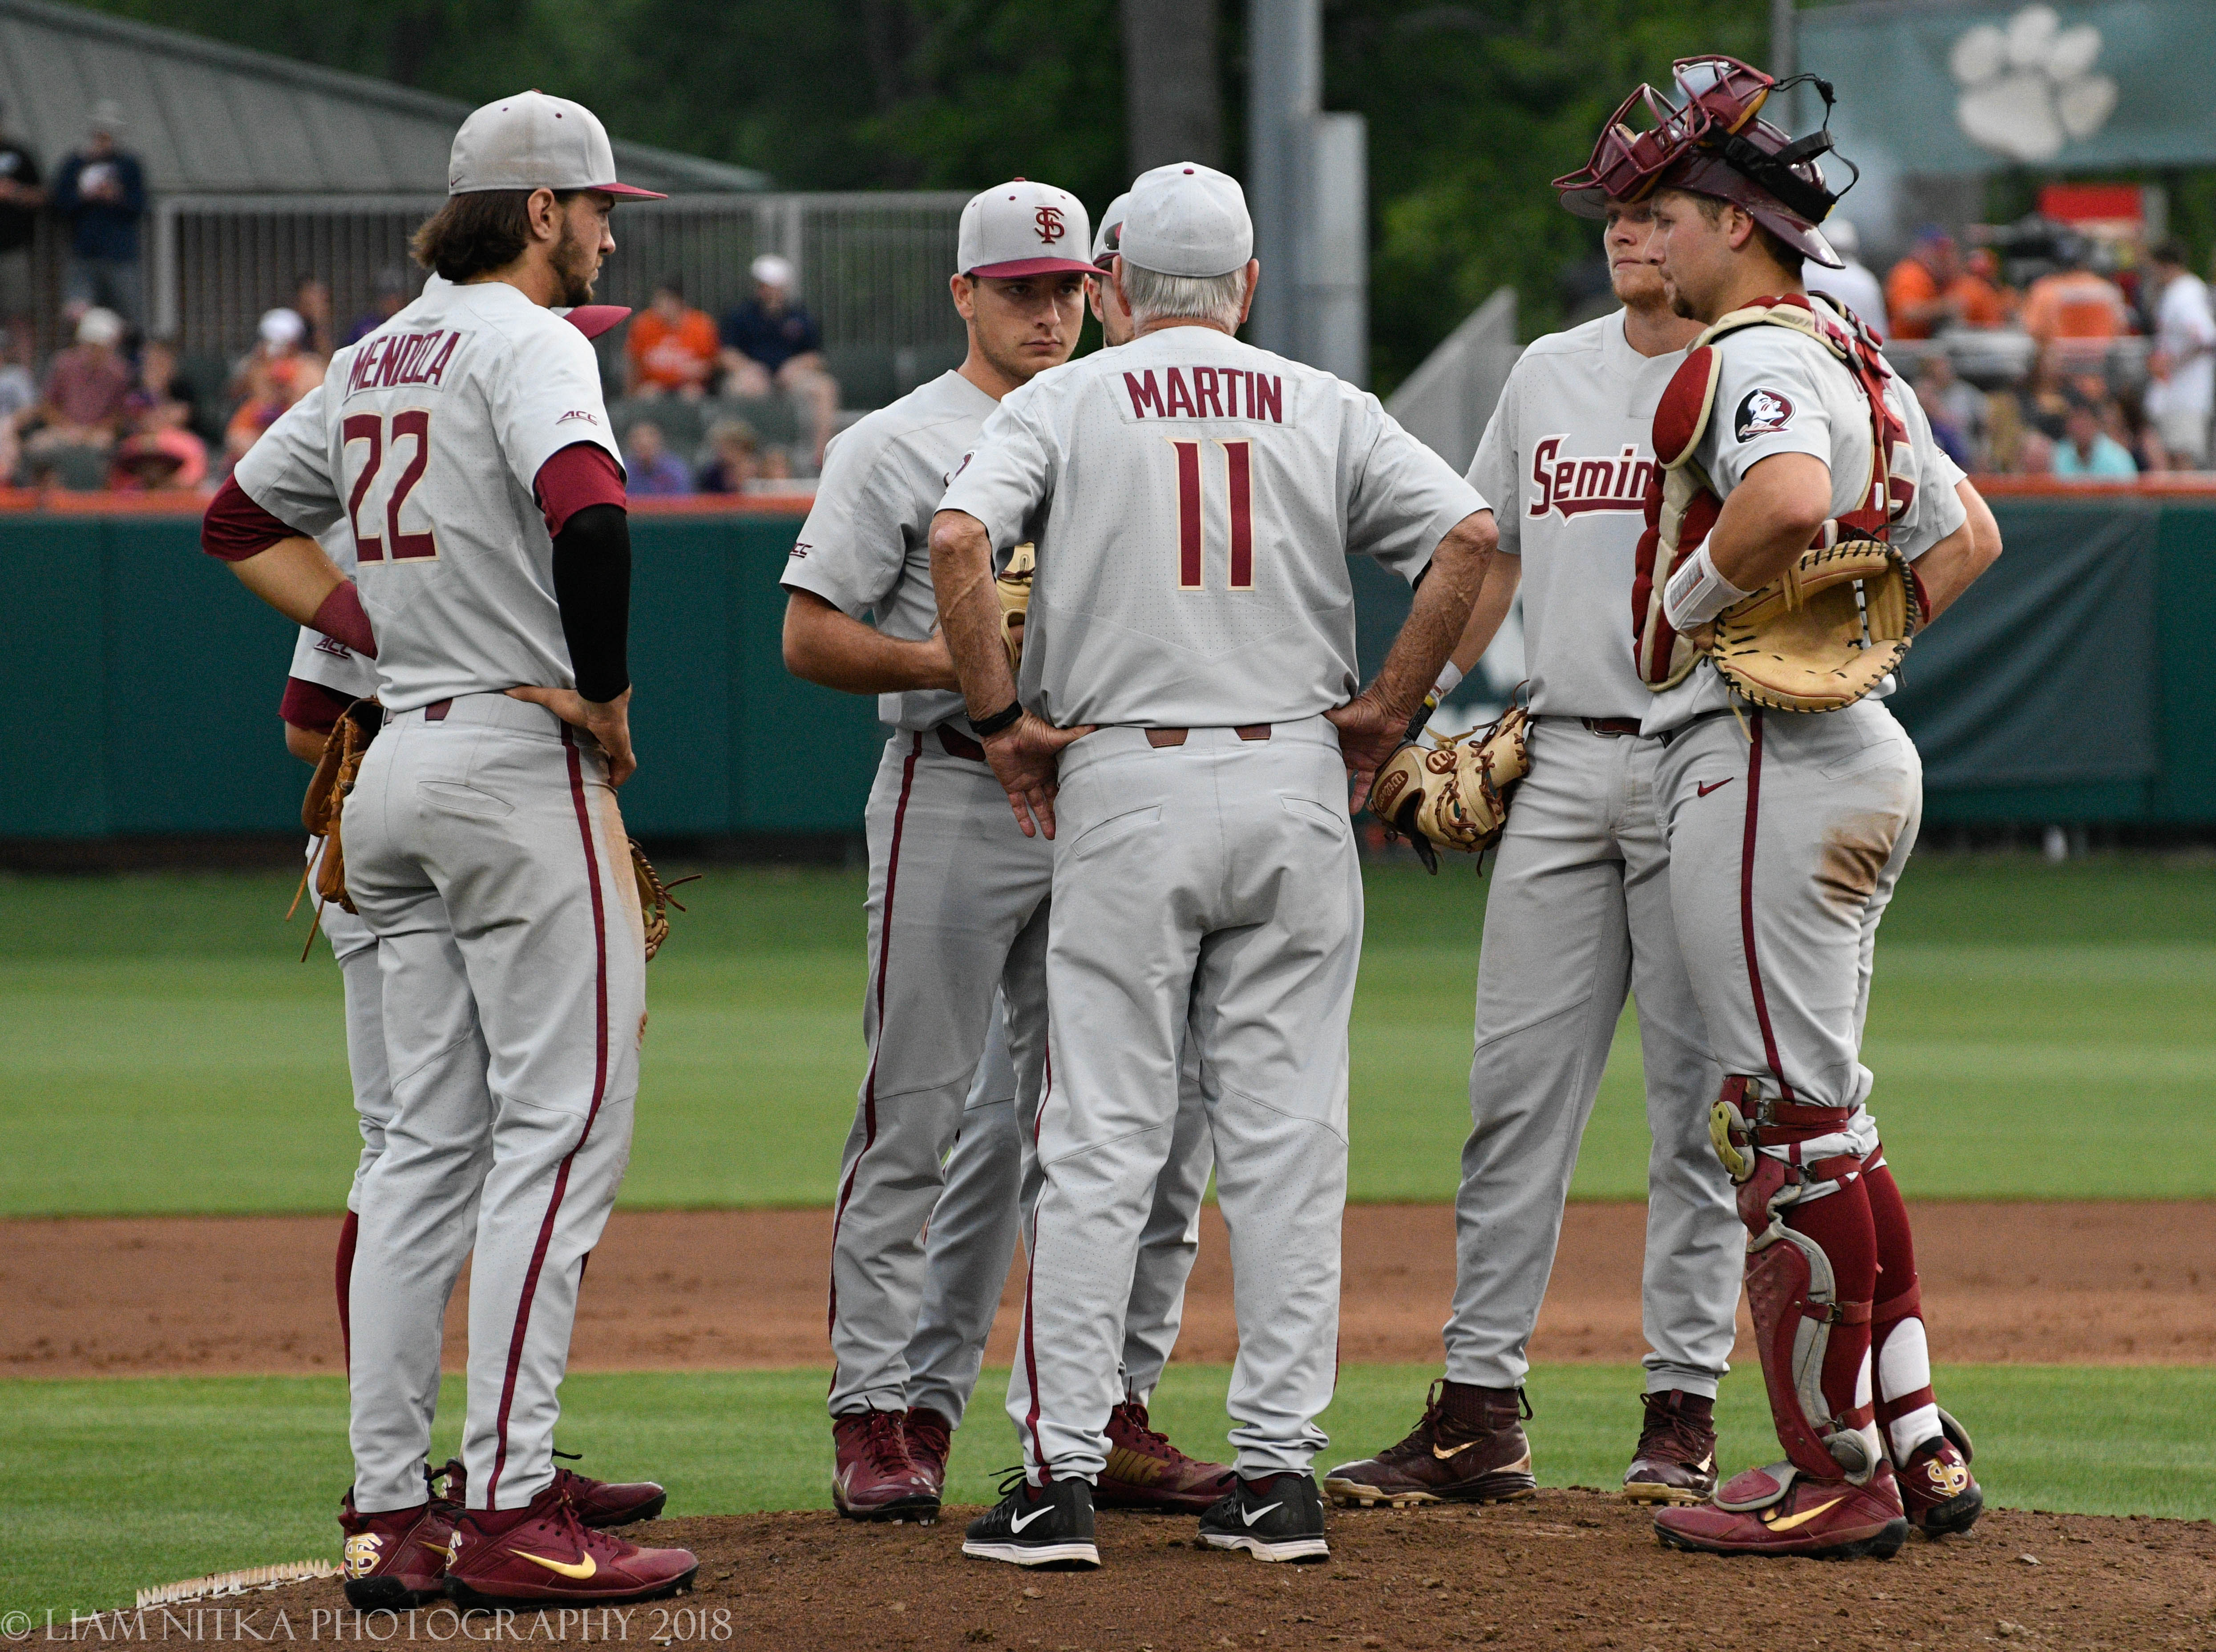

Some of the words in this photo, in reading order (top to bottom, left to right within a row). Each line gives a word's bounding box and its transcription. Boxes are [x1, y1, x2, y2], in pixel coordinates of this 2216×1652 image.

[559, 410, 598, 424] ACC
[1123, 367, 1282, 424] MARTIN
[342, 406, 440, 567] 22
[1164, 436, 1255, 591] 11
[1104, 1446, 1172, 1486] NIKE
